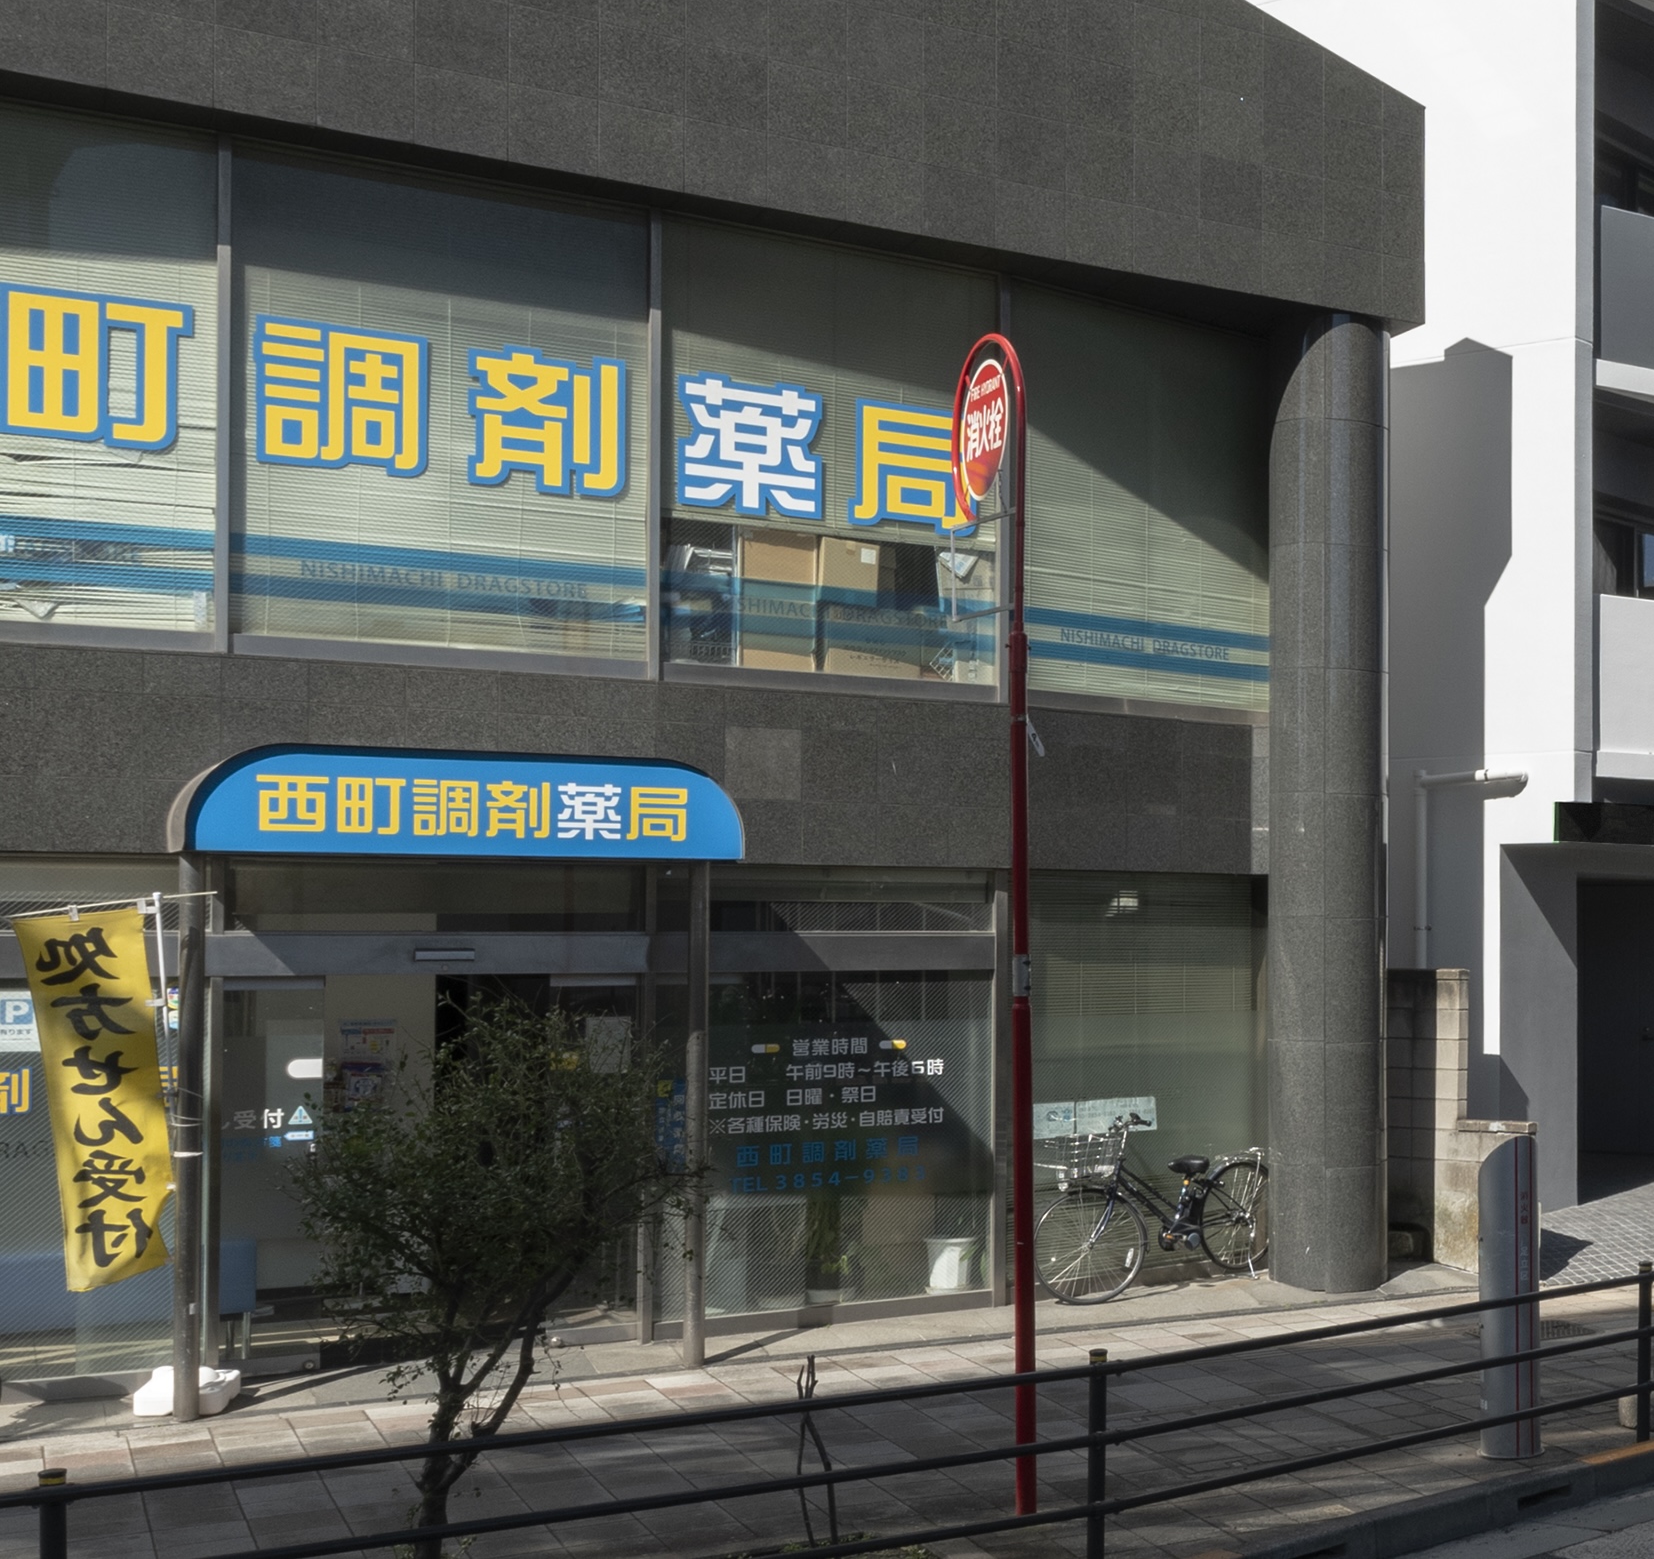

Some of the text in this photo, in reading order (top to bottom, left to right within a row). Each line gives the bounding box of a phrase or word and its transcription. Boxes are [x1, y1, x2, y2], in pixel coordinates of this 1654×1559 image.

[970, 375, 1001, 402] FIRE HYDRANT
[966, 397, 1004, 462] 消火栓
[300, 560, 589, 599] NISHIMACHI DRAGSTORE
[1060, 628, 1230, 661] NISHIMACHI DRAGSTORE
[256, 774, 689, 842] 西町調剤薬局
[5, 1001, 29, 1023] P
[792, 1036, 868, 1058] 営業時間
[708, 1066, 746, 1085] 平日
[708, 1086, 877, 1111] 定休日 日曜・祭日
[736, 1135, 919, 1168] 西町調剤薬局
[729, 1176, 768, 1195] TEL
